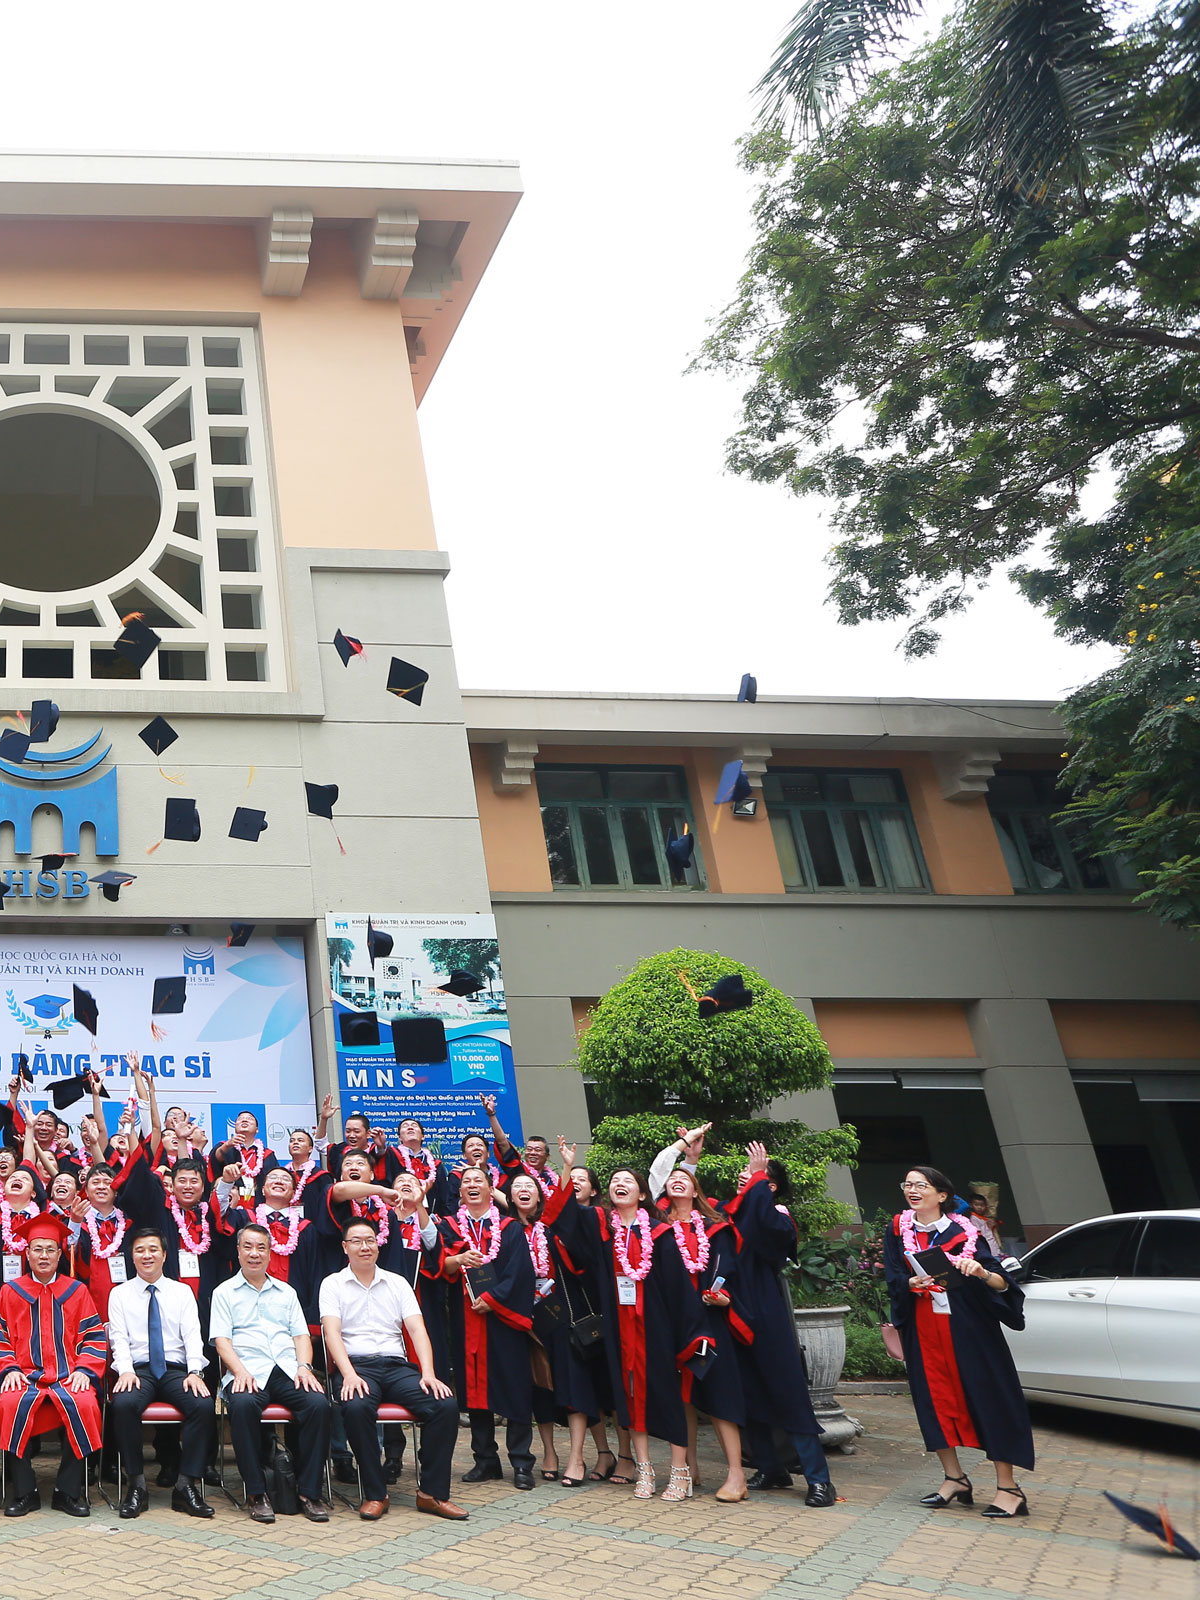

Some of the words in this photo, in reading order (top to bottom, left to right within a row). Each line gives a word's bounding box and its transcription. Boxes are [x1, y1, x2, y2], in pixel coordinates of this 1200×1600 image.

[3, 870, 90, 898] HSB
[60, 952, 79, 960] GIA
[82, 951, 98, 961] HÀ
[101, 952, 121, 963] NỘI
[24, 965, 43, 975] TRỊ
[47, 964, 62, 974] VÀ
[66, 966, 96, 975] KINH
[101, 967, 144, 976] DOANH
[185, 1052, 211, 1078] SĨ
[188, 1261, 196, 1269] 13
